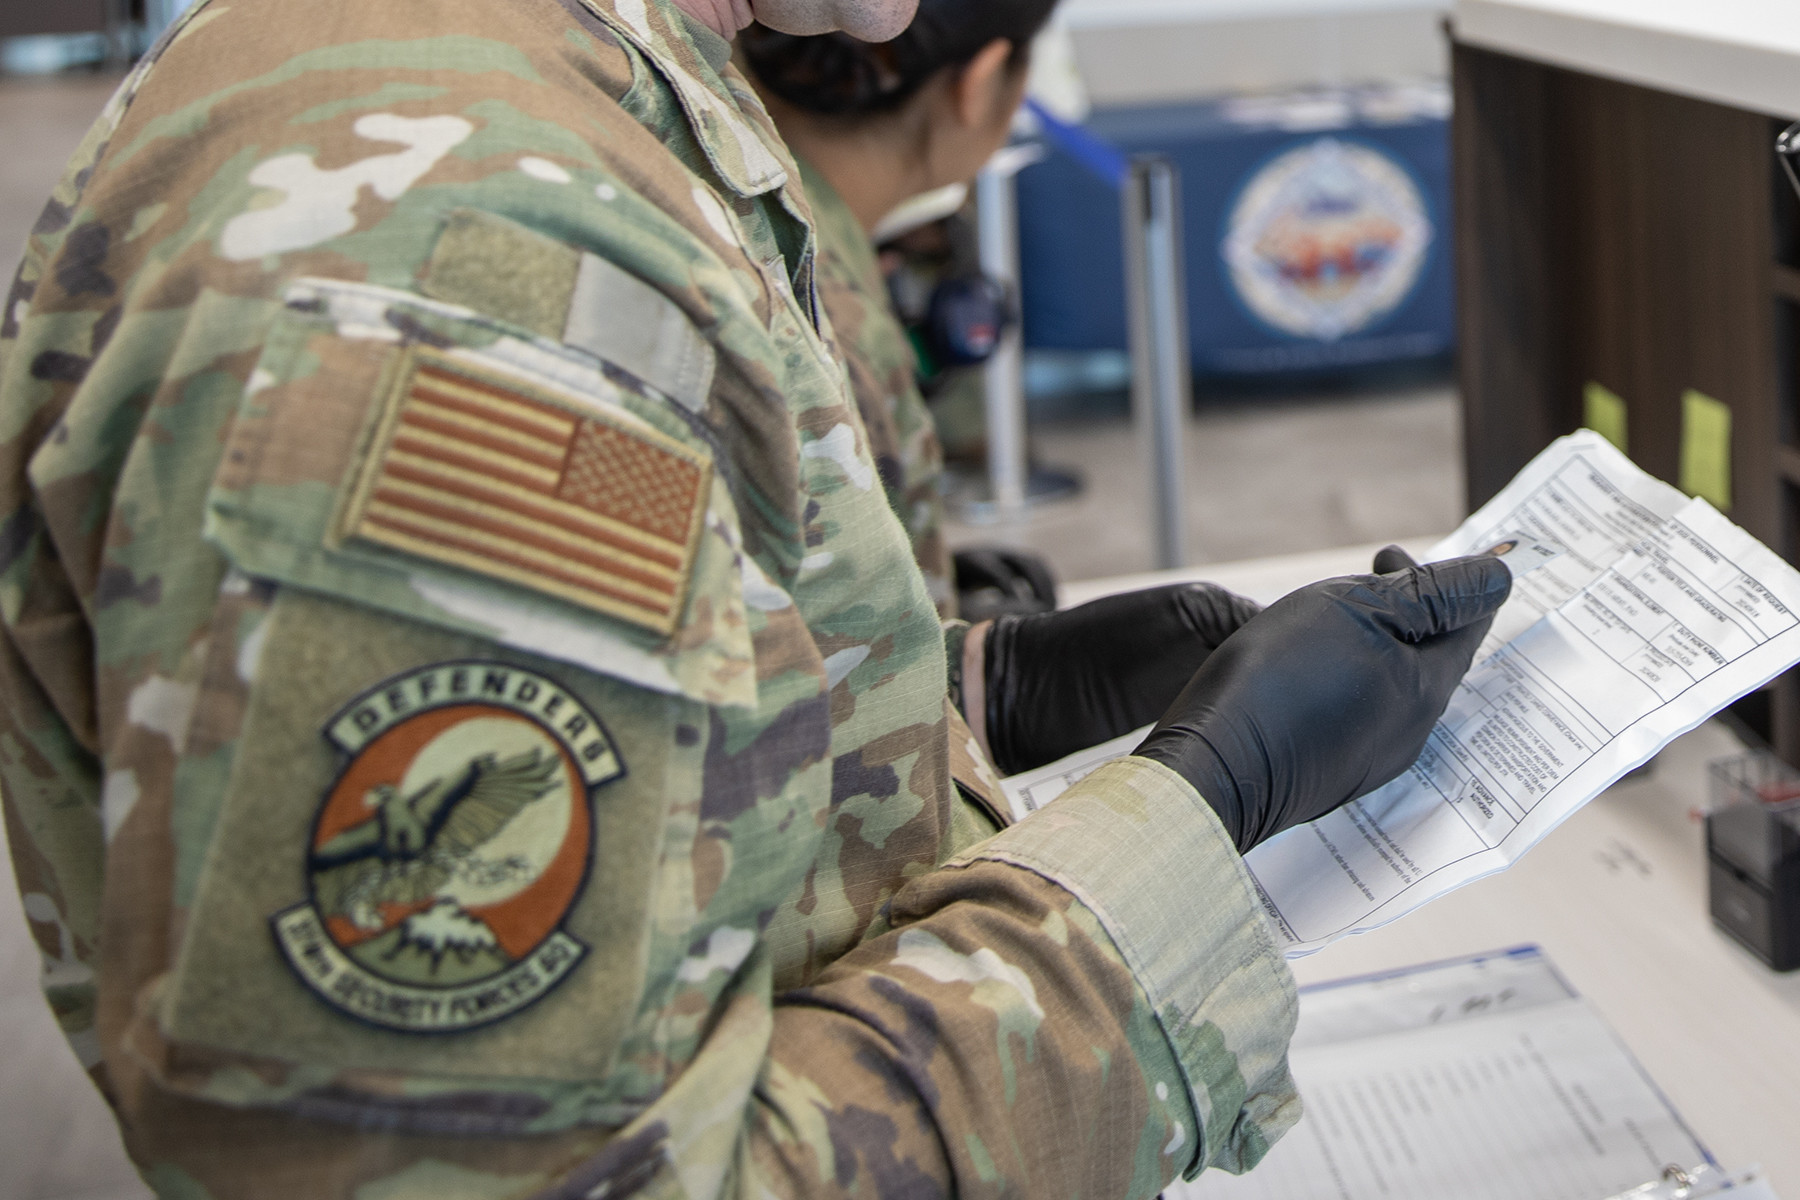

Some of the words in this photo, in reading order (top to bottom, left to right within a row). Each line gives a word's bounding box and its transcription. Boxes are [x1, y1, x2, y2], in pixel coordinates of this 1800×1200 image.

[353, 664, 607, 766] DEFENDERS
[1468, 793, 1494, 819] AUTHORIZED
[1474, 785, 1495, 805] ADVANCE
